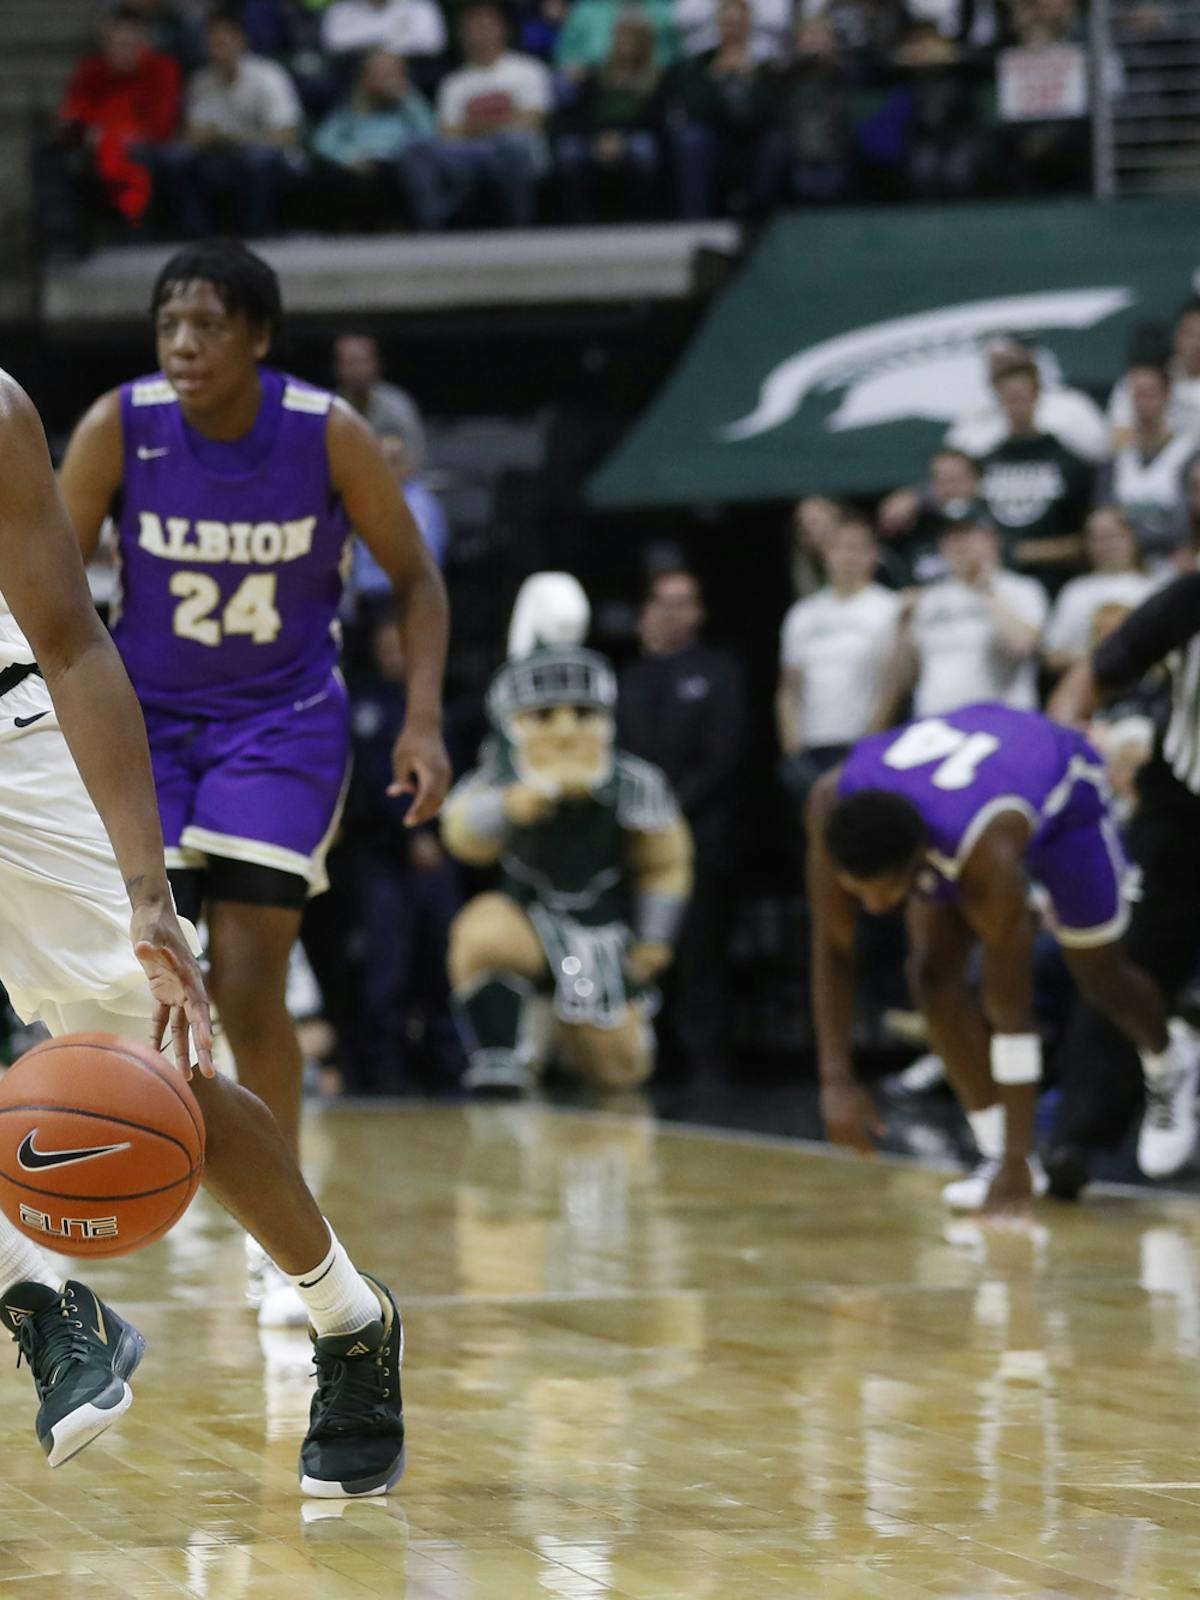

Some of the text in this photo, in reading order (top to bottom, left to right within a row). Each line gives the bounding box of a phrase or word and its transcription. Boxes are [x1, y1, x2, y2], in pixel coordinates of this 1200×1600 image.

[138, 511, 317, 564] ALBION
[169, 570, 283, 647] 24
[19, 1203, 119, 1238] ELITE
